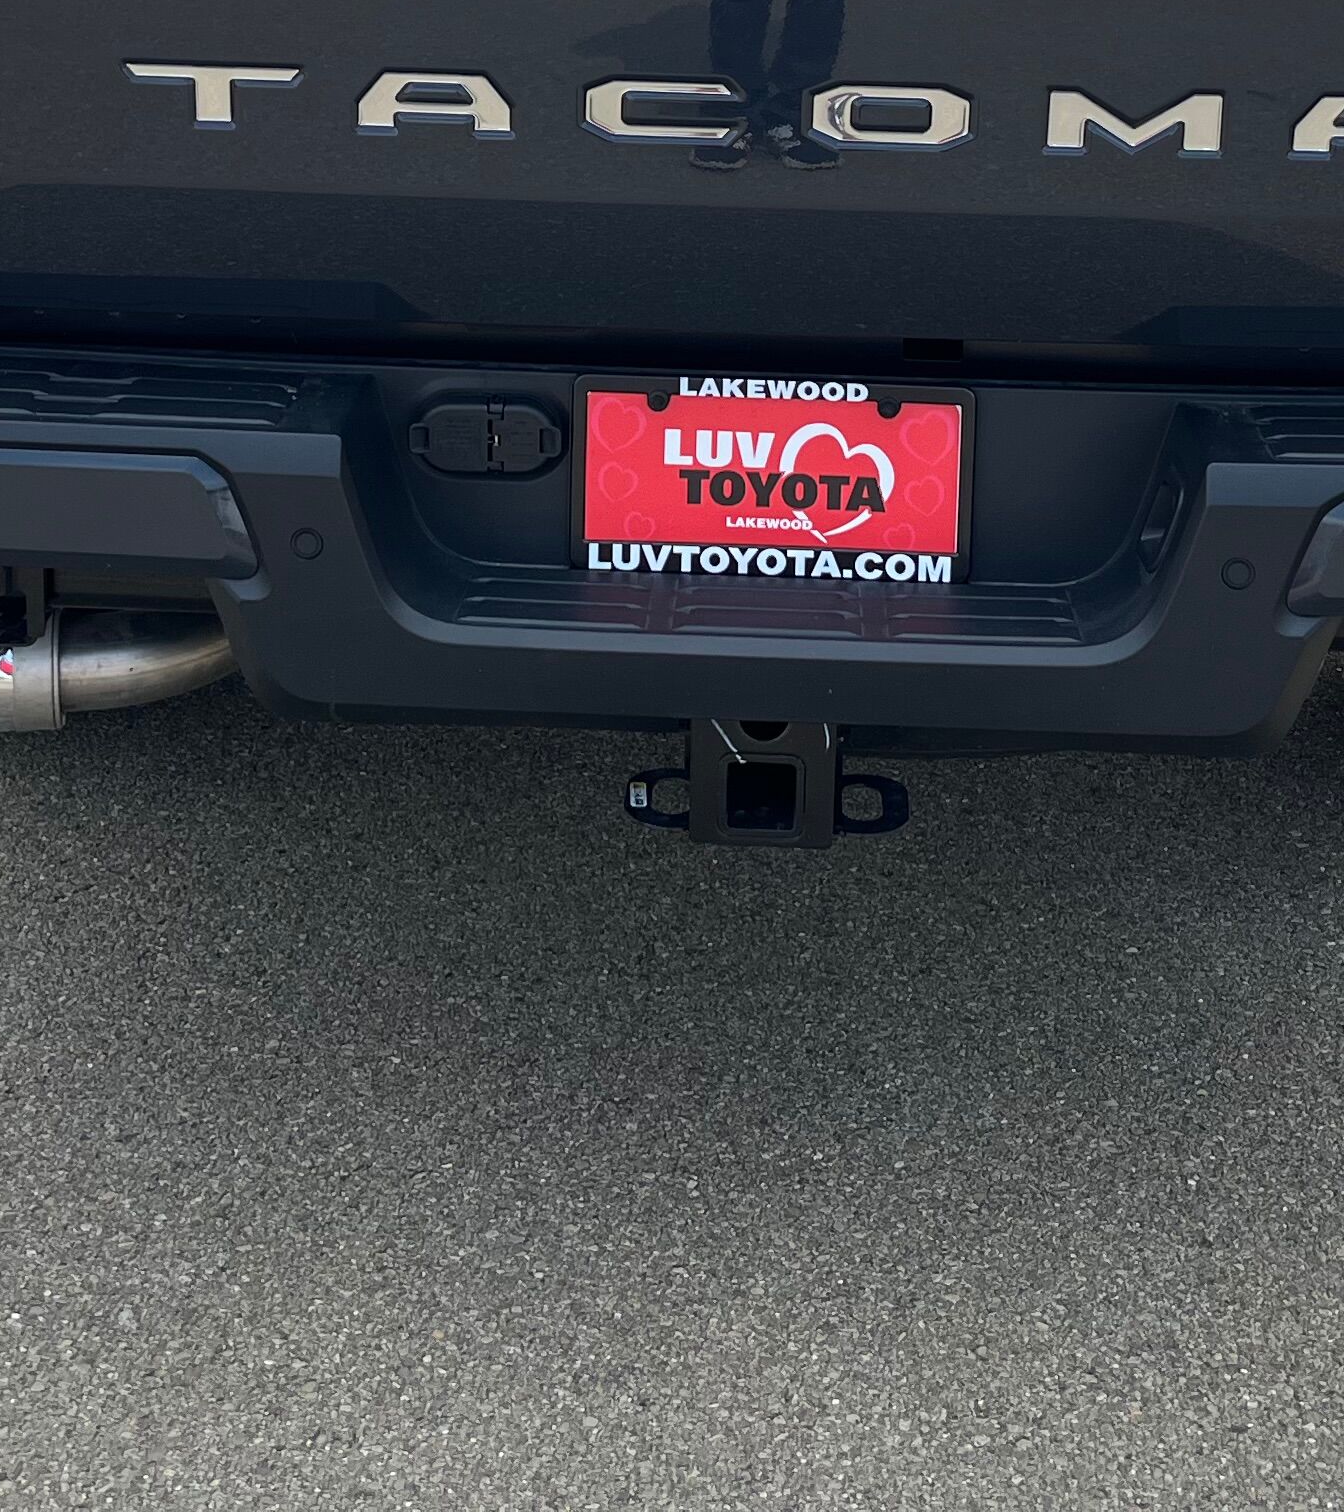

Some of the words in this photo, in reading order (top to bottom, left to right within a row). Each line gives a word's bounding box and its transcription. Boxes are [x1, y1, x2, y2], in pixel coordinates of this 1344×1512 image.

[679, 376, 869, 402] LAKEWOOD
[663, 428, 776, 468] LUV
[679, 469, 886, 513] TOYOTA
[725, 516, 813, 531] LAKEWOOD
[588, 542, 952, 583] LUVTOYOTA.COM
